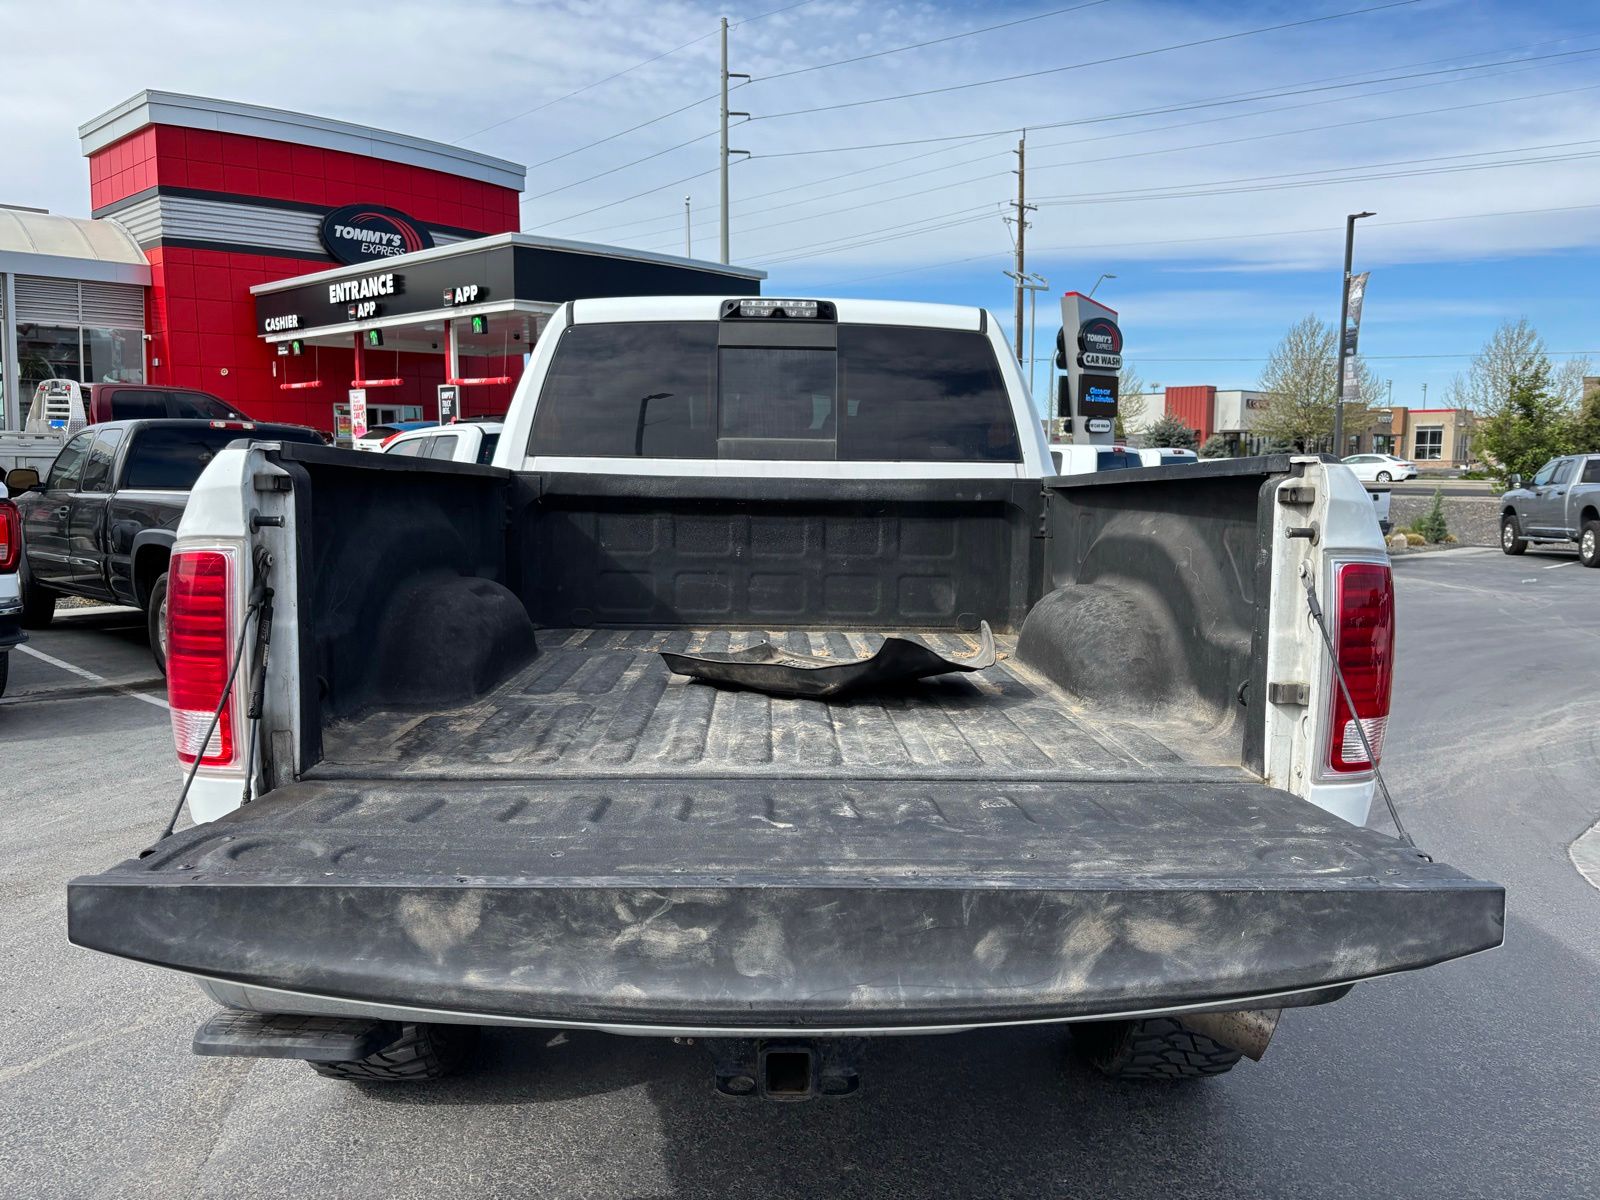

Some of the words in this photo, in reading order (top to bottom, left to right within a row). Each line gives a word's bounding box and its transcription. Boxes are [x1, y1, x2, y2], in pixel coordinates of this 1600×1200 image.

[334, 225, 402, 247] TOMMY'S
[361, 242, 406, 257] EXPRESS
[329, 273, 394, 304] ENTRANCE
[454, 284, 478, 304] APP
[357, 301, 376, 318] APP
[265, 314, 298, 331] CASHIER
[1087, 334, 1112, 344] TOMMY'S
[1085, 354, 1100, 365] CAR
[1101, 355, 1120, 366] WASH
